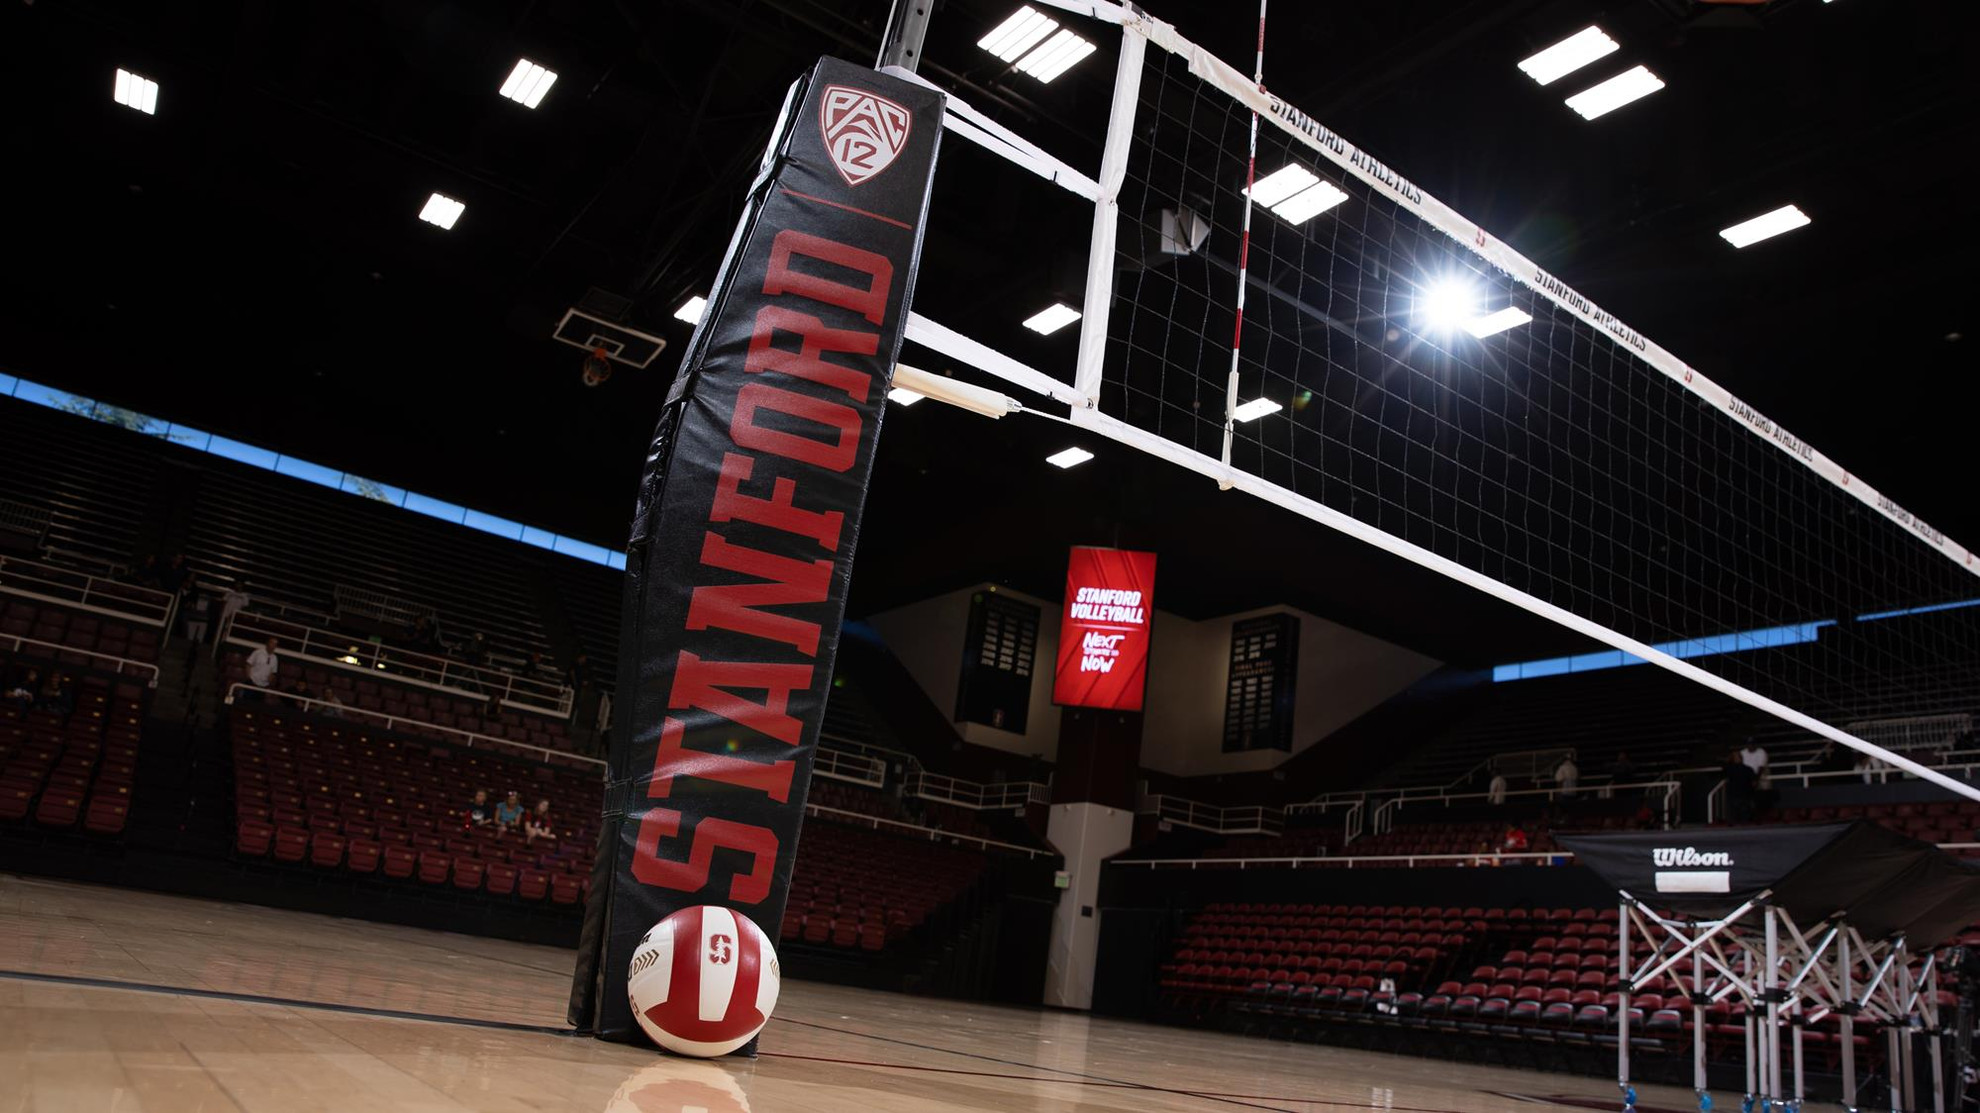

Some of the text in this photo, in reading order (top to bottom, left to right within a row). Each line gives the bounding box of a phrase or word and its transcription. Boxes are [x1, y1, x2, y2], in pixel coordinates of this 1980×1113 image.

[826, 91, 906, 155] PAC
[841, 138, 877, 170] 12
[1269, 96, 1345, 156] STANFORD
[1349, 147, 1422, 206] ATHLETICS
[1534, 268, 1647, 351] STANFORD ATHLETICS
[631, 229, 894, 904] STANFORD
[1076, 587, 1142, 607] STANFORD
[1070, 603, 1144, 624] VOLLEYBALL
